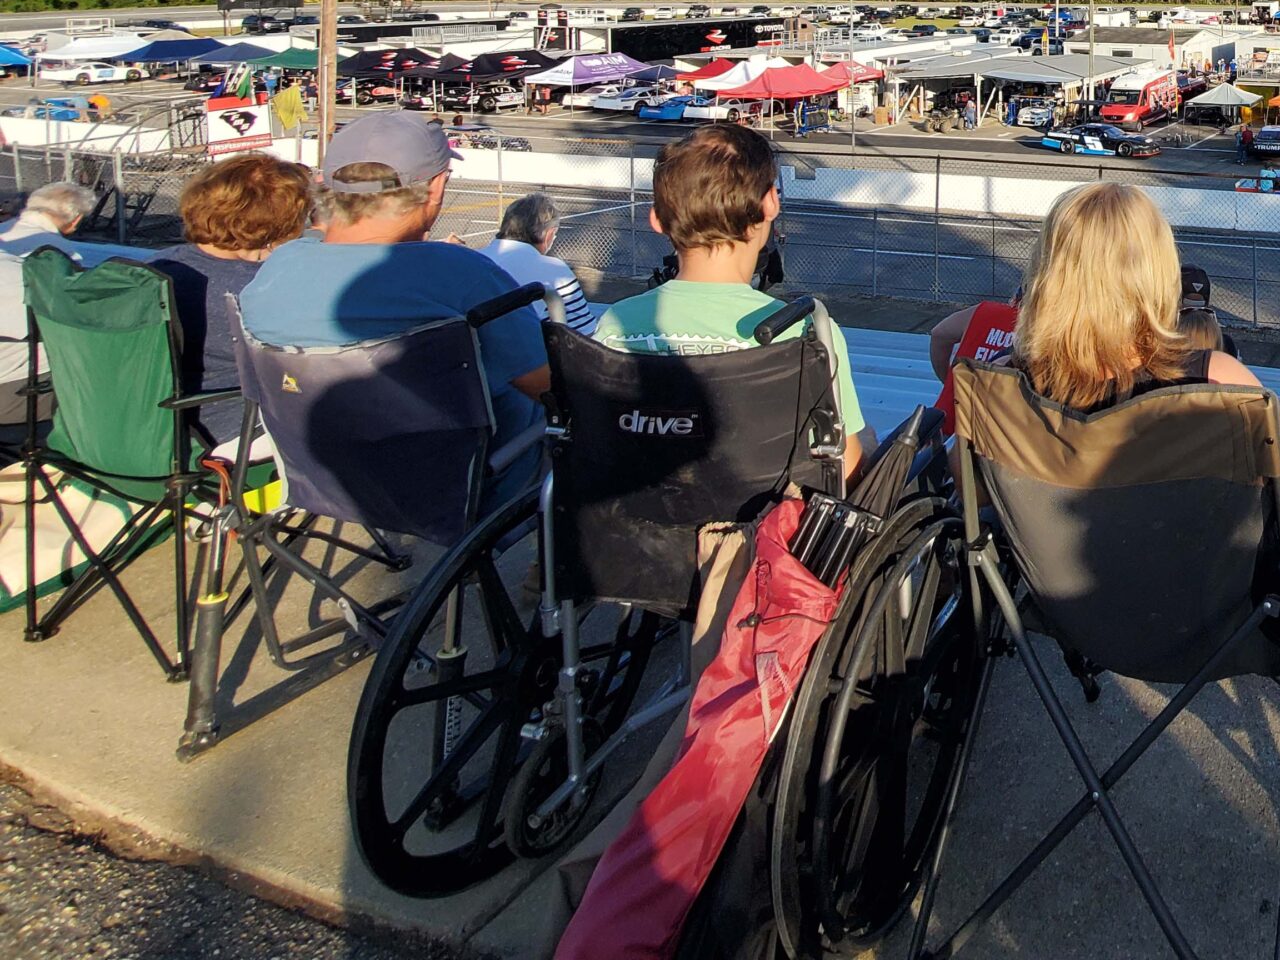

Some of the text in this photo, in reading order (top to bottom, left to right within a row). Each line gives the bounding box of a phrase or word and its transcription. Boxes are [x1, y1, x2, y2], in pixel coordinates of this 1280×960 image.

[763, 24, 785, 32] TOYOTA
[1083, 136, 1104, 150] 5
[618, 409, 694, 435] drive
